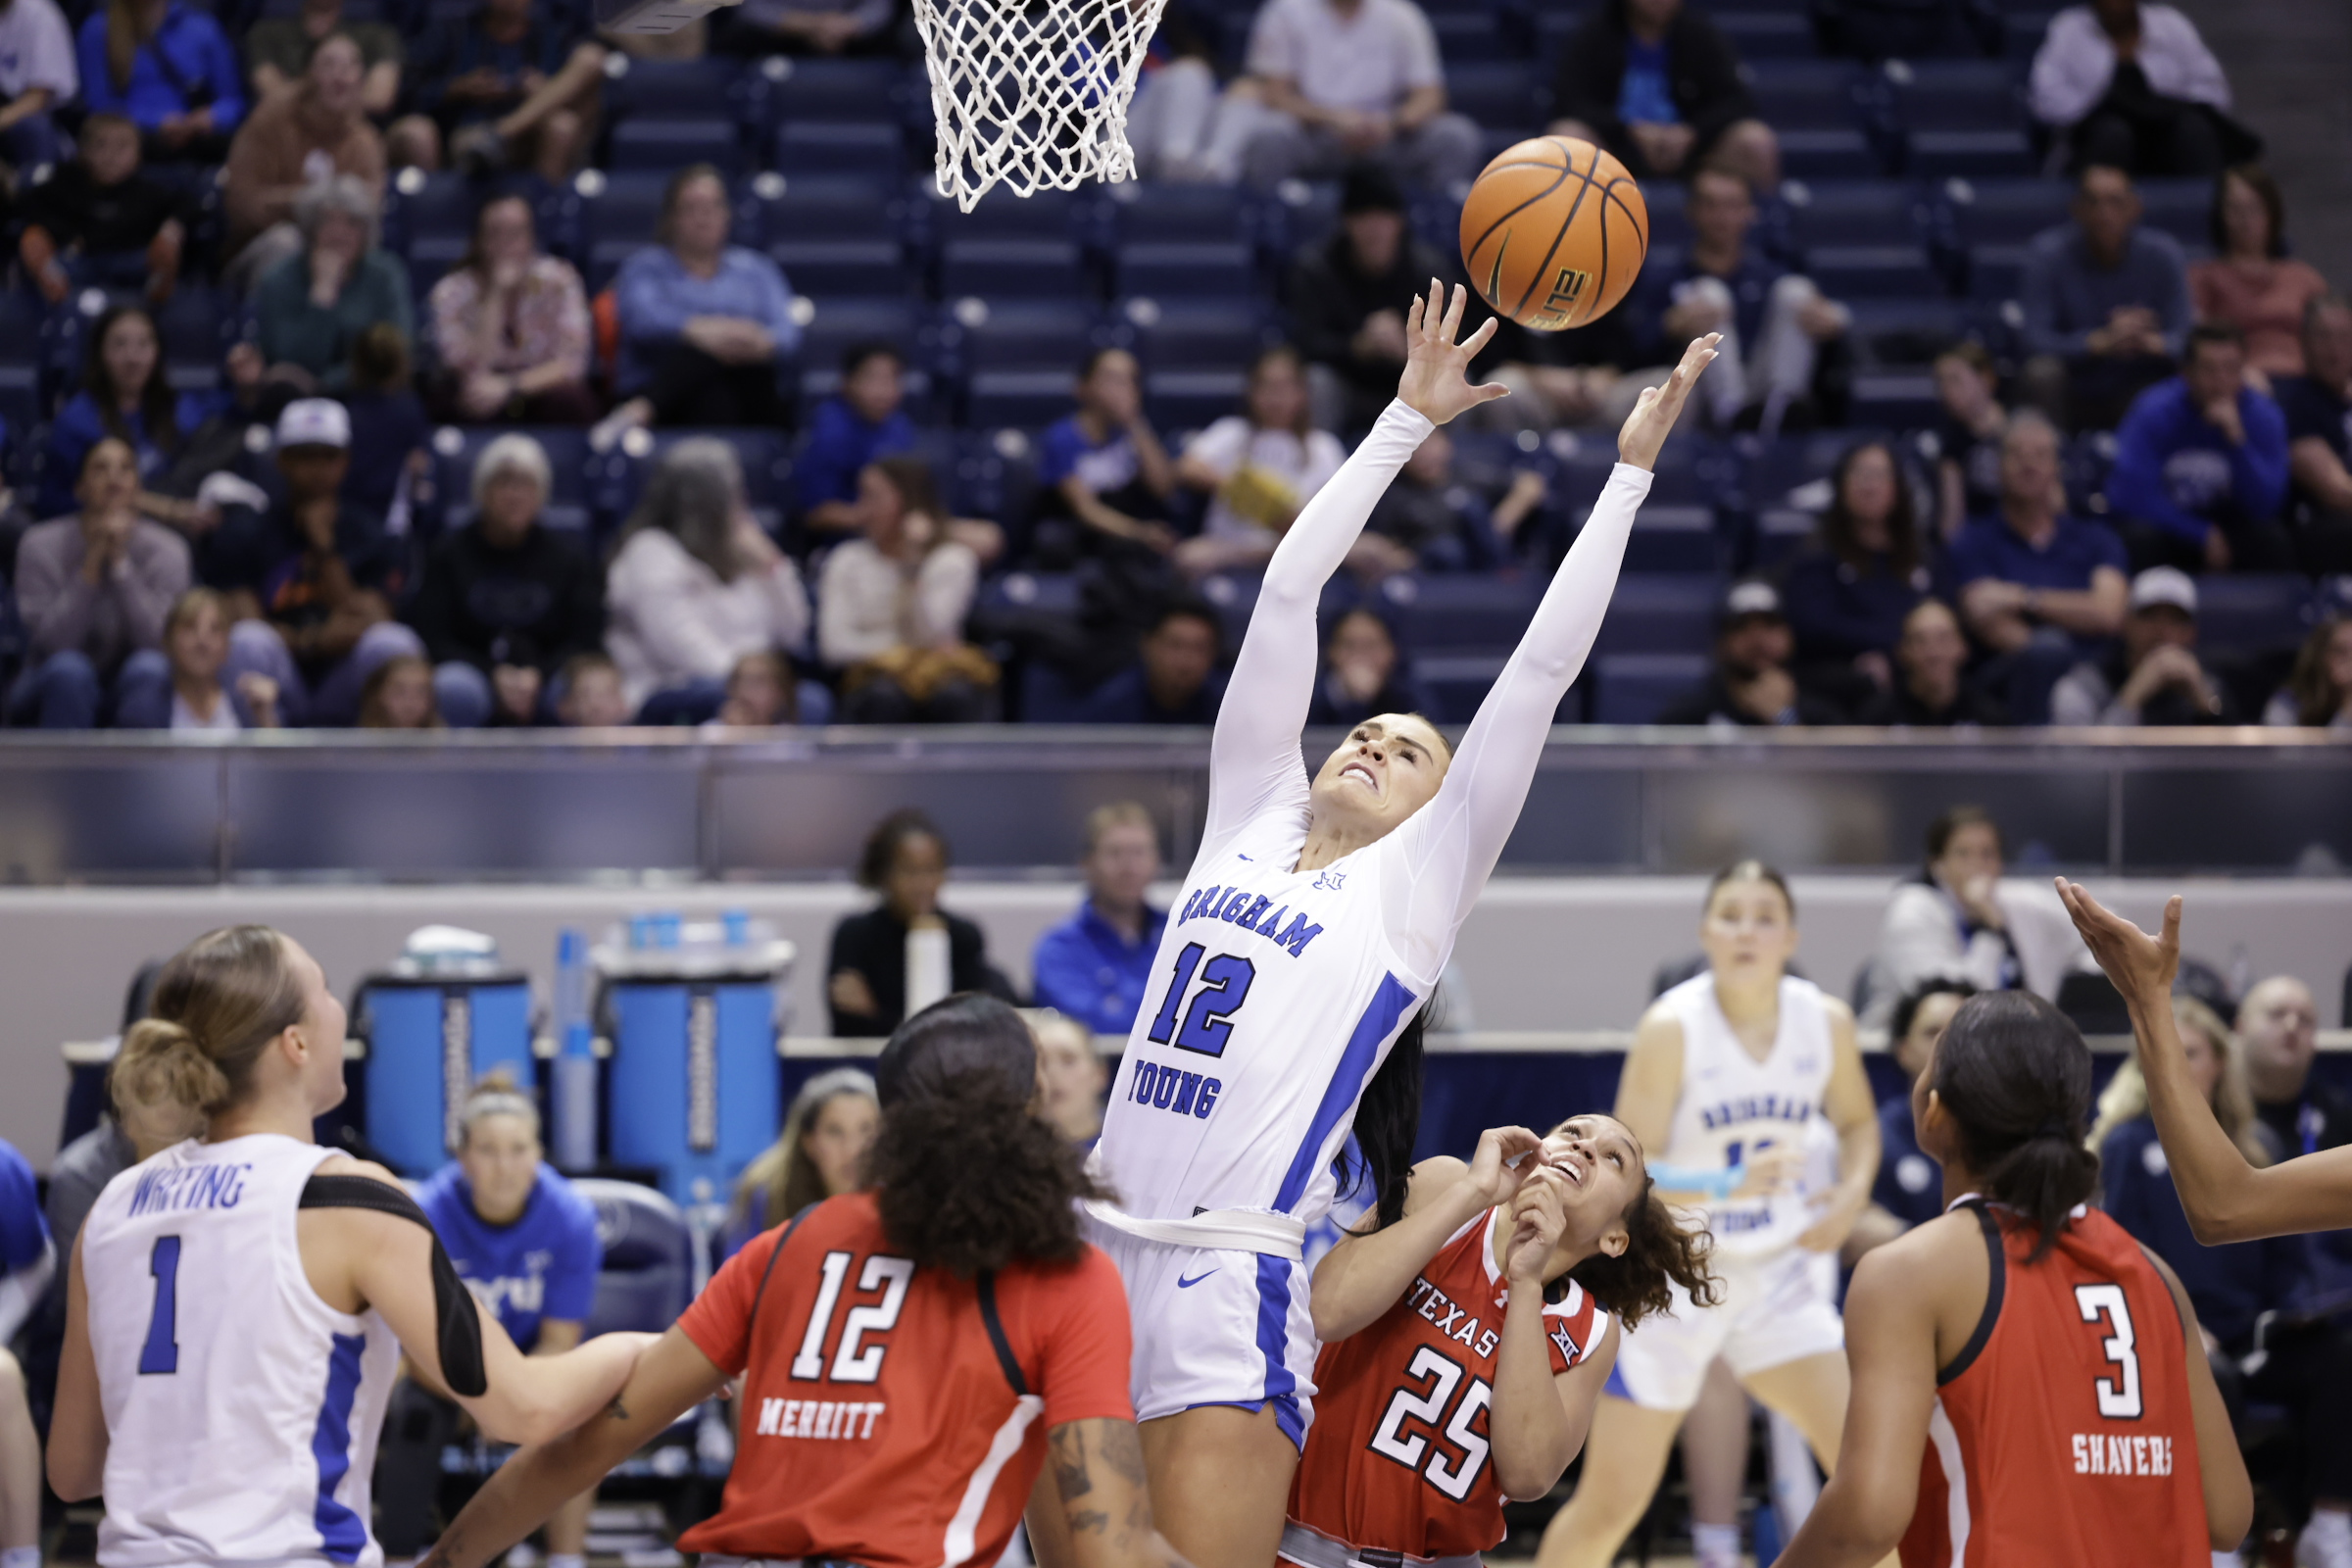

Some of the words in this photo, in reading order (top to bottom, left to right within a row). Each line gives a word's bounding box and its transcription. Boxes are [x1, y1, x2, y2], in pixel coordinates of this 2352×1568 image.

[1177, 884, 1324, 958] BRIGHAM
[1148, 941, 1256, 1058] 12
[1128, 1059, 1221, 1119] YOUNG
[137, 1234, 181, 1375] 1
[790, 1250, 915, 1384] 12
[1402, 1276, 1500, 1359] TEXAS
[2074, 1283, 2144, 1420] 3
[757, 1397, 886, 1440] MERRITT
[1366, 1343, 1493, 1503] 25
[2072, 1433, 2173, 1476] SHAVERS
